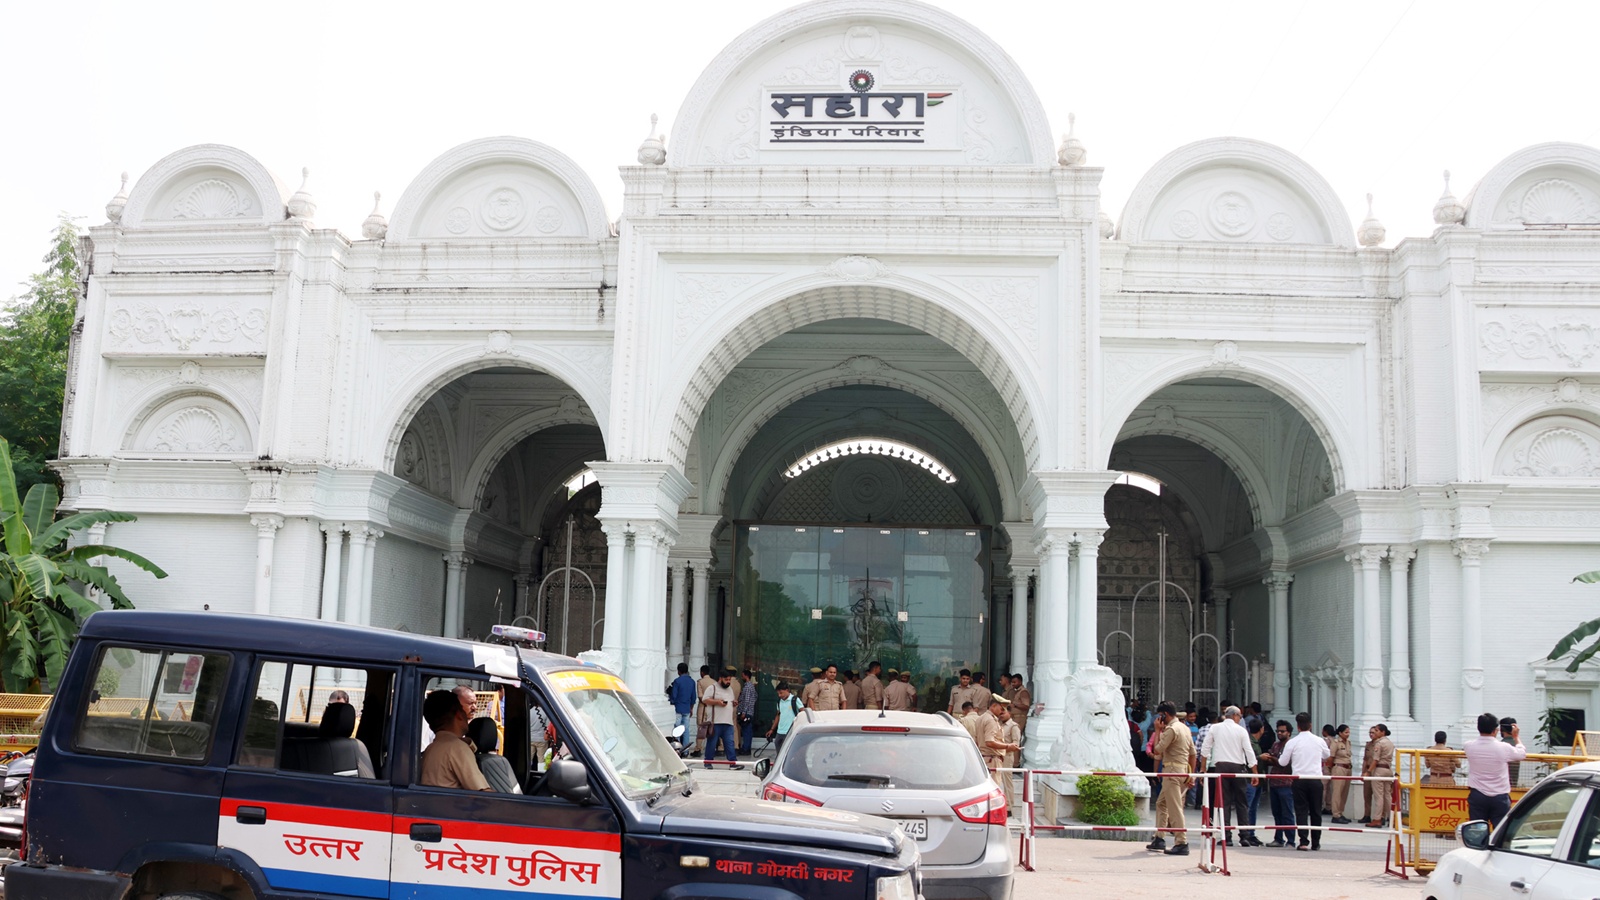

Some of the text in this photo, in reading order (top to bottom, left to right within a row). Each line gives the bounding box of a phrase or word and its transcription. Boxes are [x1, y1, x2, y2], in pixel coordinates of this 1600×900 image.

[770, 92, 925, 118] सहारा
[770, 126, 924, 139] इंडिया परिवार
[1429, 813, 1461, 829] पुलिस
[283, 833, 601, 886] उत्तर प्रदेश पुलिस
[716, 859, 855, 883] थाना गोमती नगर
